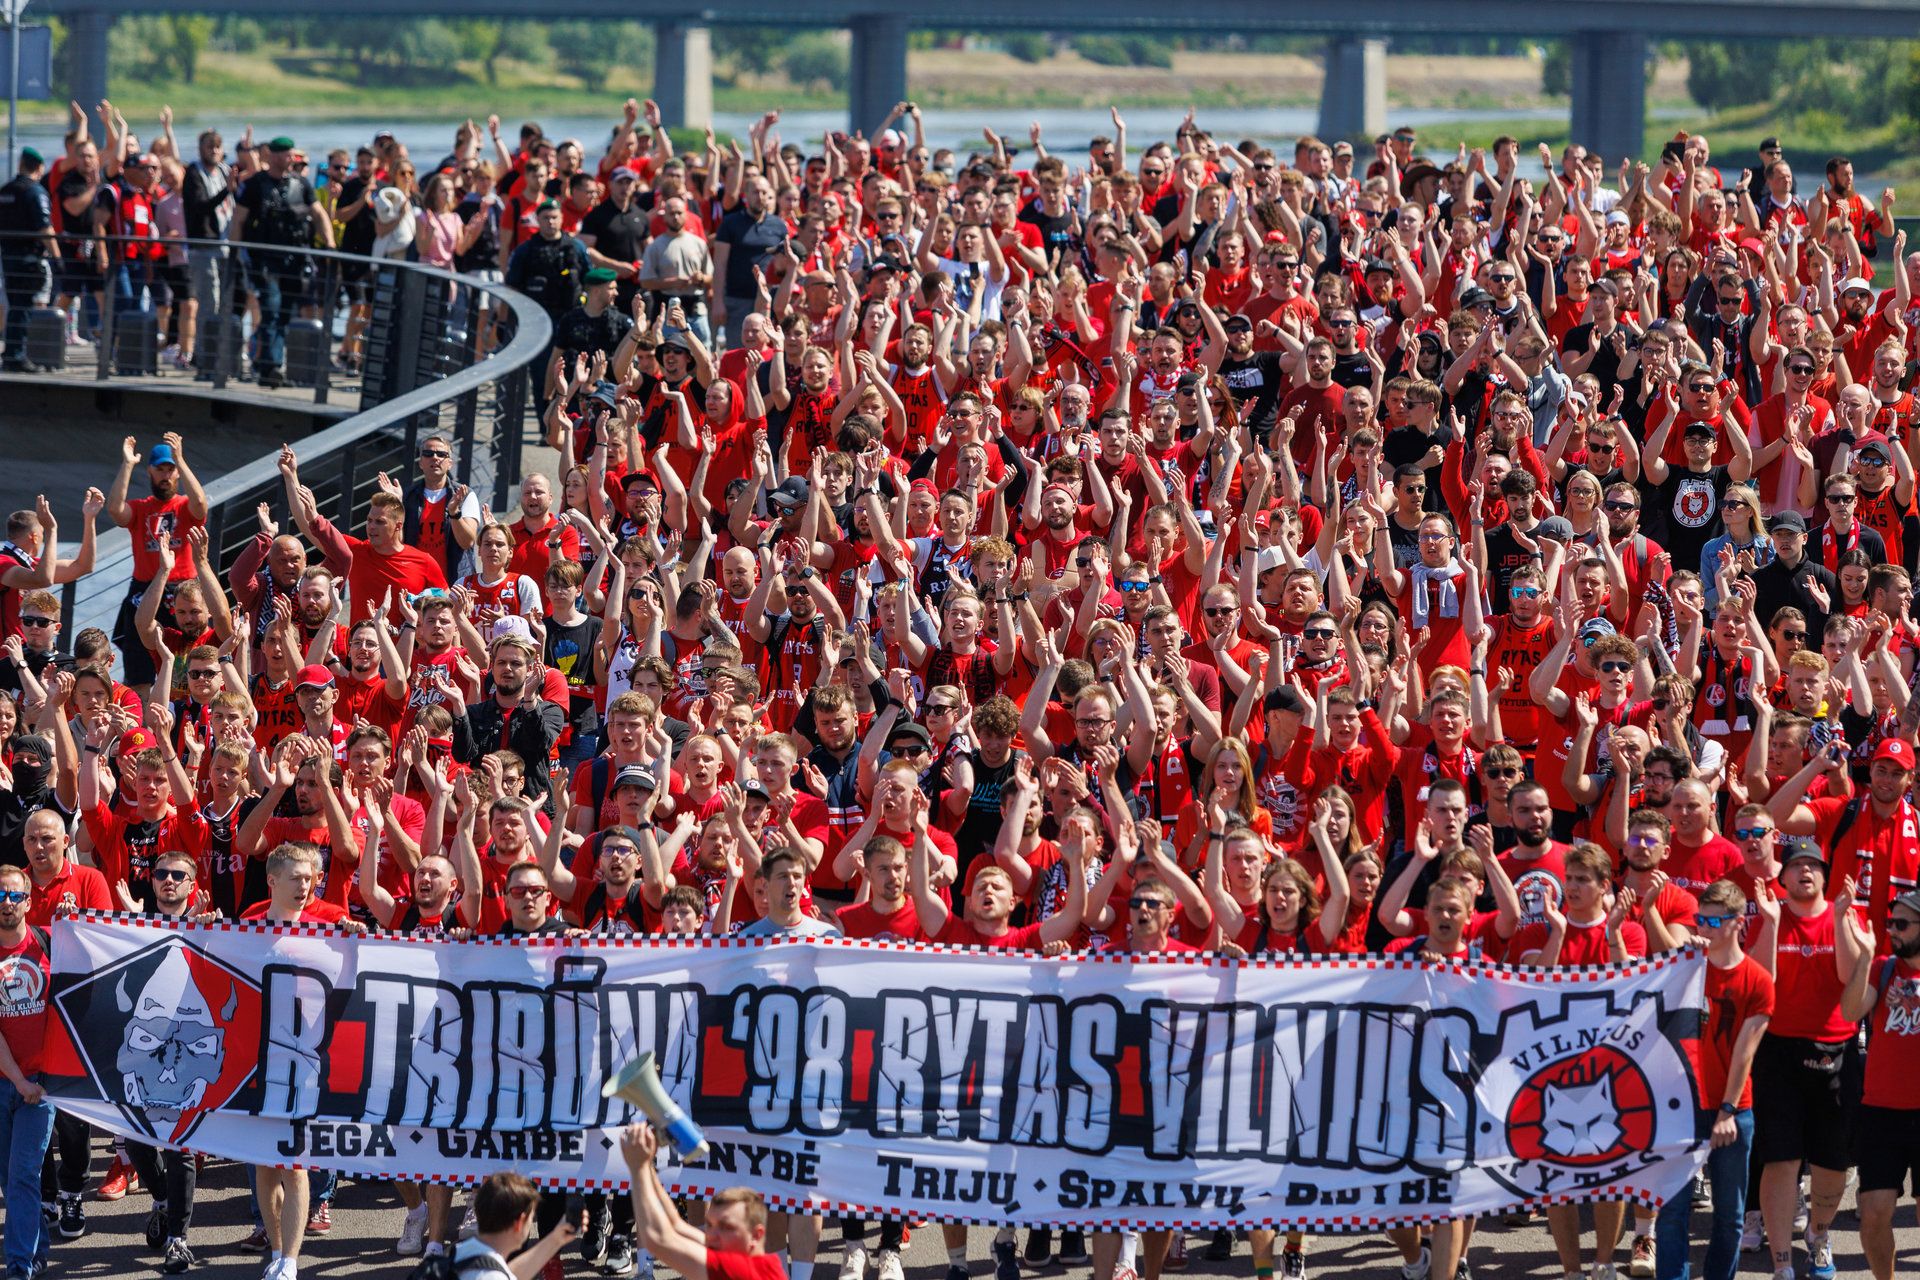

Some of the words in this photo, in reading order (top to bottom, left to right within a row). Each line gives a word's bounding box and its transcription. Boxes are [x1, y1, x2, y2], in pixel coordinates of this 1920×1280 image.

[258, 964, 328, 1120] R
[874, 992, 1119, 1155] RYTAS
[1145, 1001, 1476, 1172] VILNIUS
[1510, 1024, 1645, 1073] VILNUS
